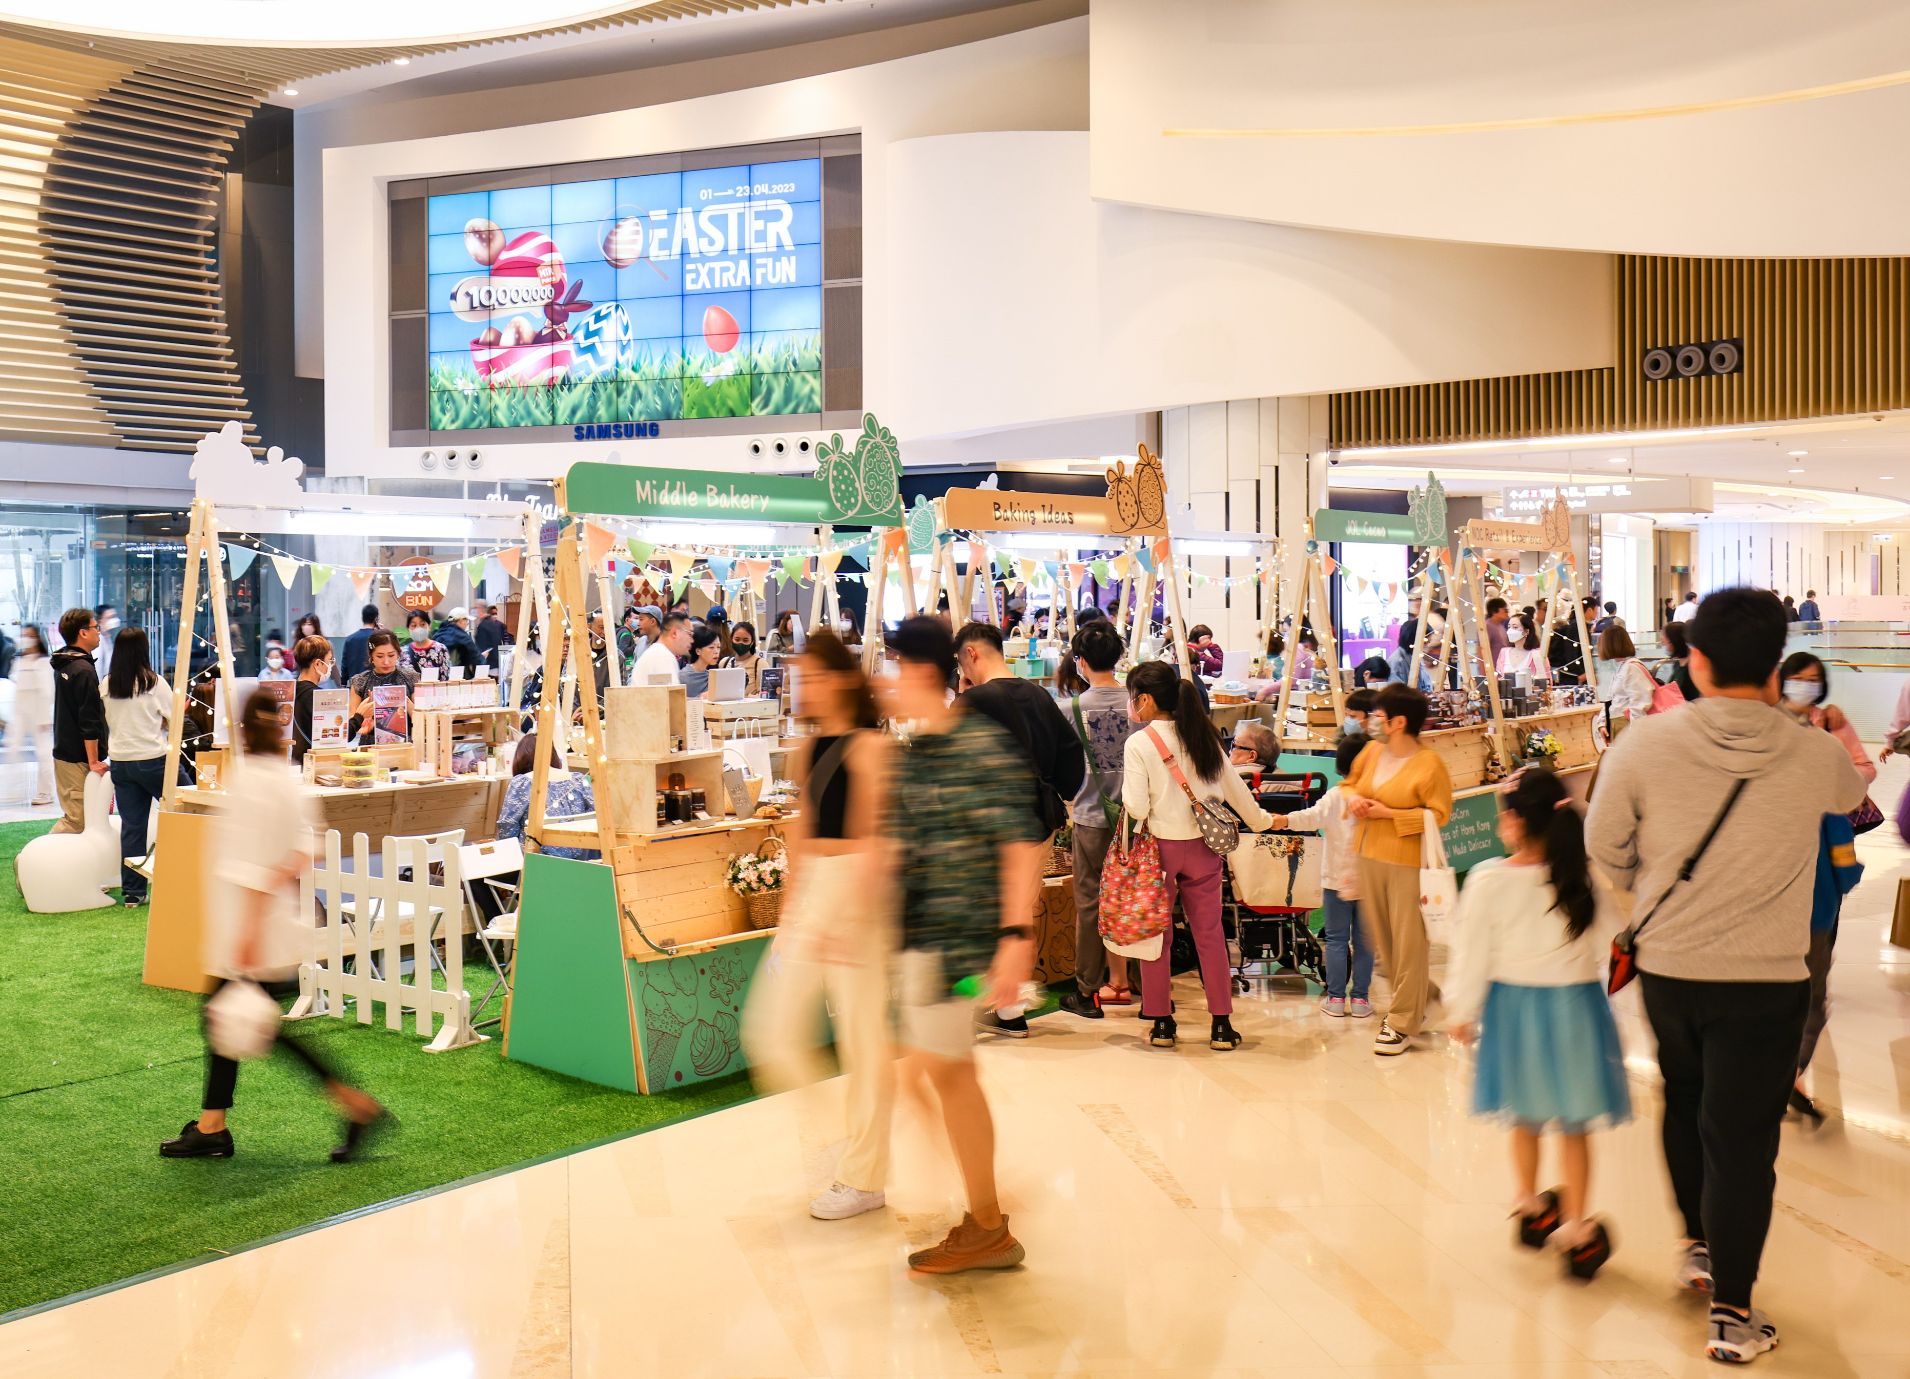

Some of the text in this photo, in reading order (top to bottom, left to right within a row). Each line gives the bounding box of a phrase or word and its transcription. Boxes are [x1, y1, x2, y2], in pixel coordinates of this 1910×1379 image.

[648, 199, 796, 261] EASTER
[685, 256, 797, 290] EXTRA FUN
[574, 422, 660, 441] SAMSUNG
[635, 479, 769, 513] Middle Bakery
[993, 501, 1074, 526] Baking Ideas
[1461, 824, 1475, 835] Hong
